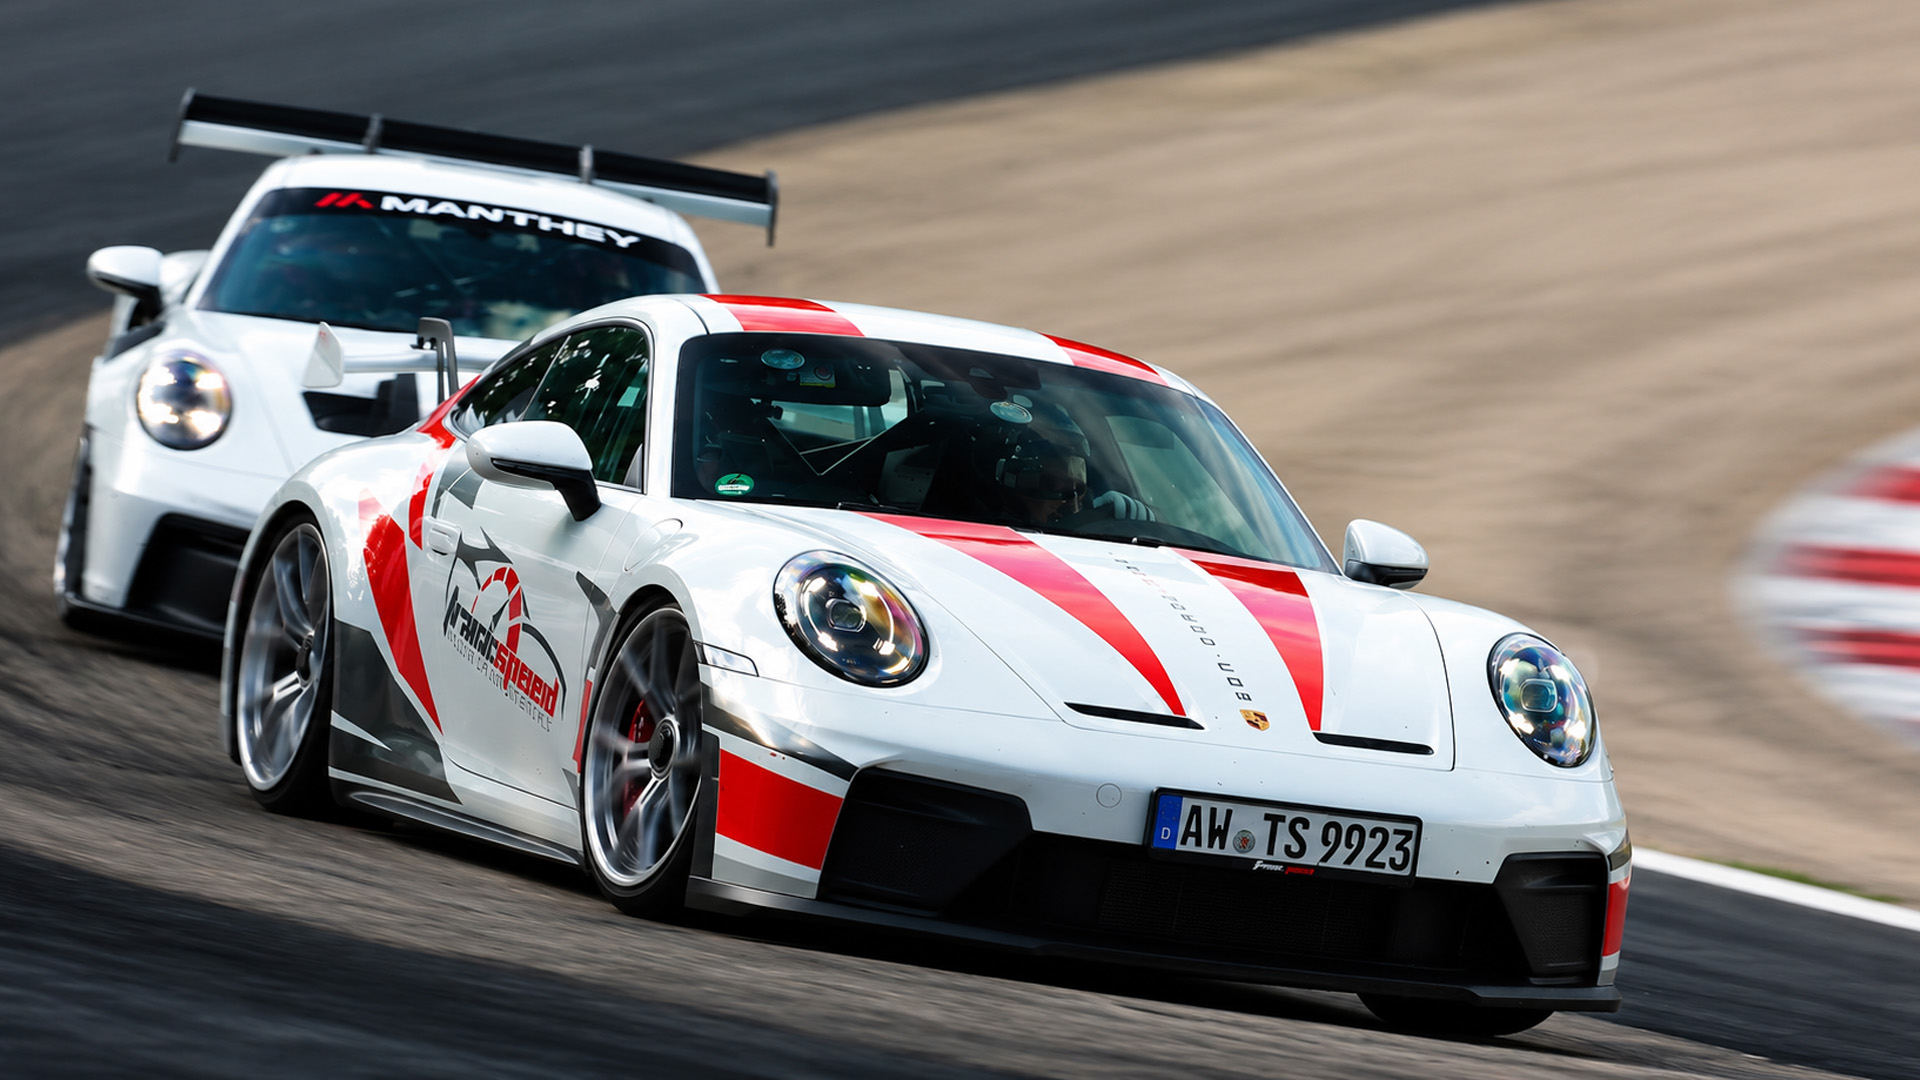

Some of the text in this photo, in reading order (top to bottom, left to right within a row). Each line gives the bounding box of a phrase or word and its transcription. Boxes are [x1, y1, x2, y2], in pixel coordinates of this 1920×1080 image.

[380, 195, 641, 249] MANTHEY
[1160, 826, 1171, 841] D
[1180, 804, 1233, 850] AW
[1263, 812, 1310, 859] TS
[1317, 820, 1414, 871] 9923
